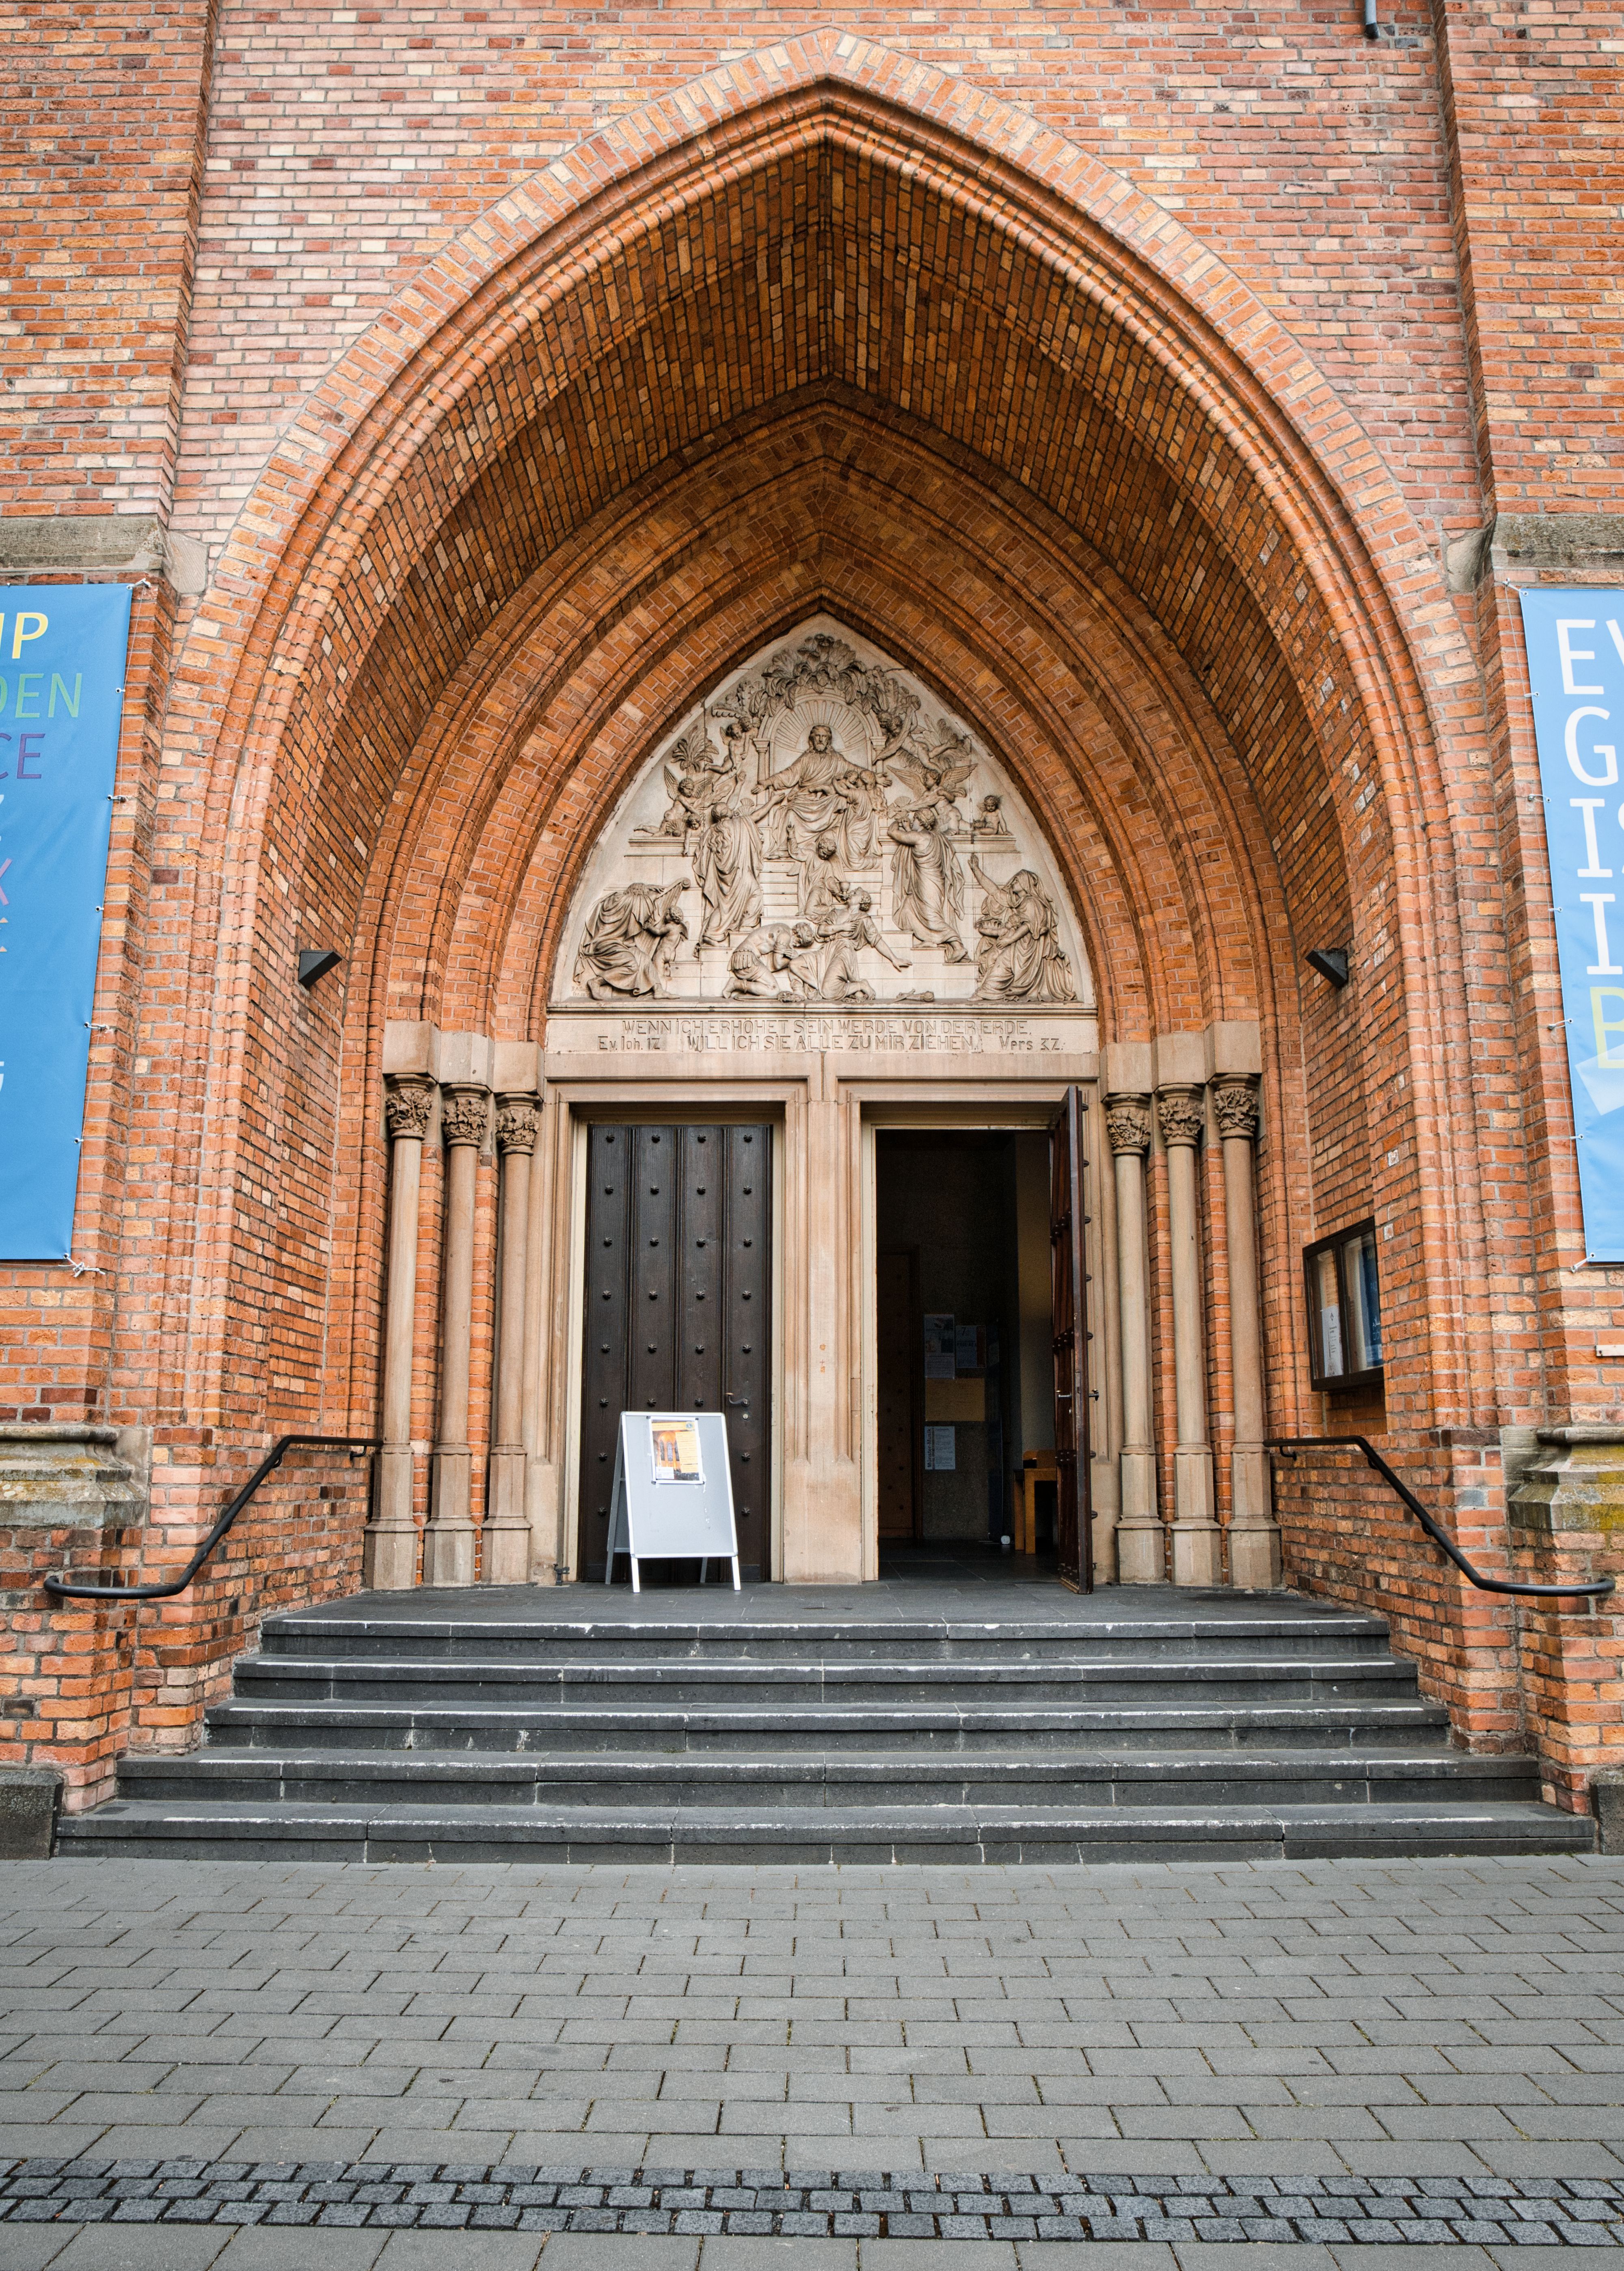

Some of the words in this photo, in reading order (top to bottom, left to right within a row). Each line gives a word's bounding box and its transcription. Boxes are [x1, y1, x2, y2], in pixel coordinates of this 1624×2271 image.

[0, 612, 49, 659] P
[0, 673, 82, 718] EN
[598, 1036, 618, 1050] Ev.
[687, 1034, 727, 1050] WILL
[732, 1034, 759, 1050] ICH
[764, 1034, 790, 1049] SIE
[796, 1036, 843, 1050] ALLE
[848, 1035, 871, 1049] ZU
[875, 1034, 904, 1050] MIR
[909, 1034, 976, 1050] ZIEHEN.
[999, 1036, 1033, 1050] Vers
[622, 1021, 671, 1034] WENN
[676, 1019, 703, 1034] ICH
[794, 1019, 833, 1034] SEIN
[838, 1020, 897, 1034] WERDE
[902, 1020, 936, 1034] VON
[941, 1020, 976, 1034] DER
[980, 1020, 1032, 1035] ERDE,
